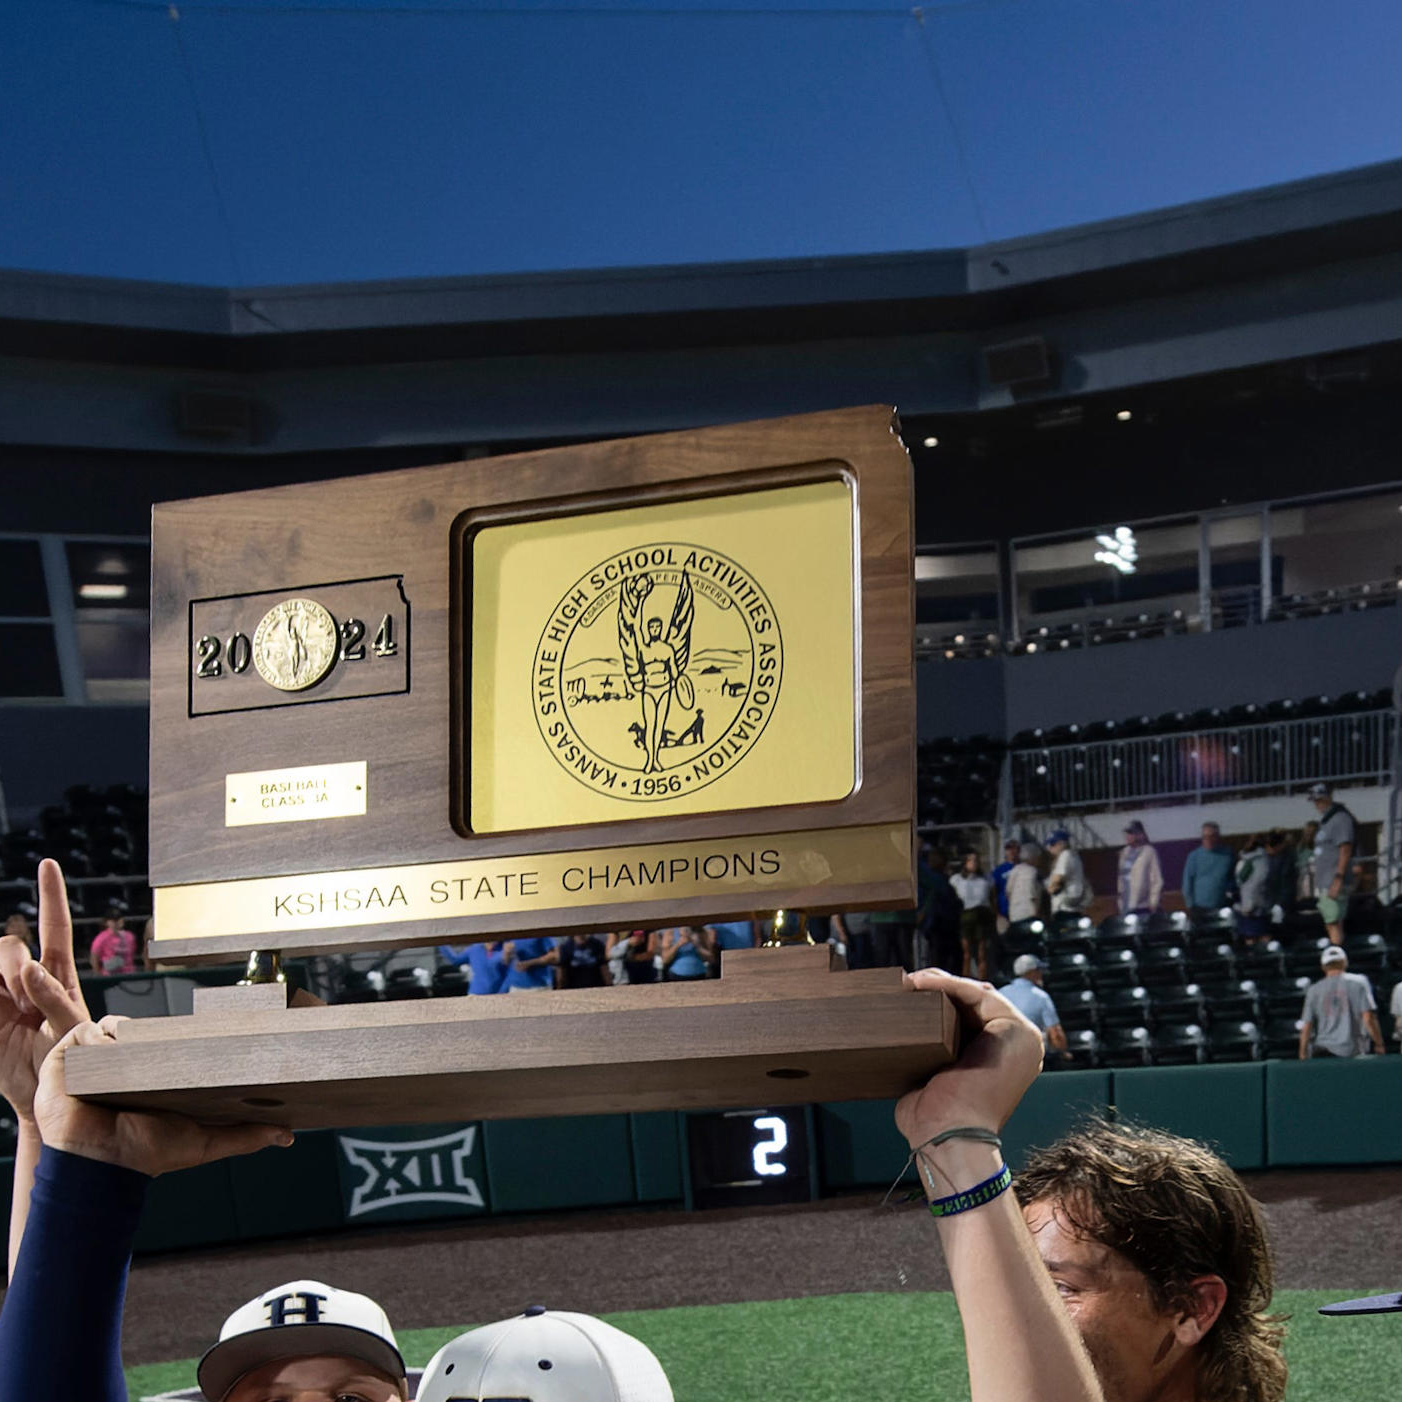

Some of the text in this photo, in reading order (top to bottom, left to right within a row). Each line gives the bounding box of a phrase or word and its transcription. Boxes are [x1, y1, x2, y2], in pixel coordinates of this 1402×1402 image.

[694, 580, 727, 605] ASPERA
[197, 631, 251, 677] 20
[340, 614, 397, 660] 24
[539, 549, 776, 788] KANSAS STATE HIGH SCHOOL ACTIVITIES ASSOCIATION
[630, 775, 681, 796] 1956
[275, 849, 781, 917] KSHSAA STATE CHAMPIONS
[752, 1116, 788, 1176] 2
[264, 1291, 327, 1325] H
